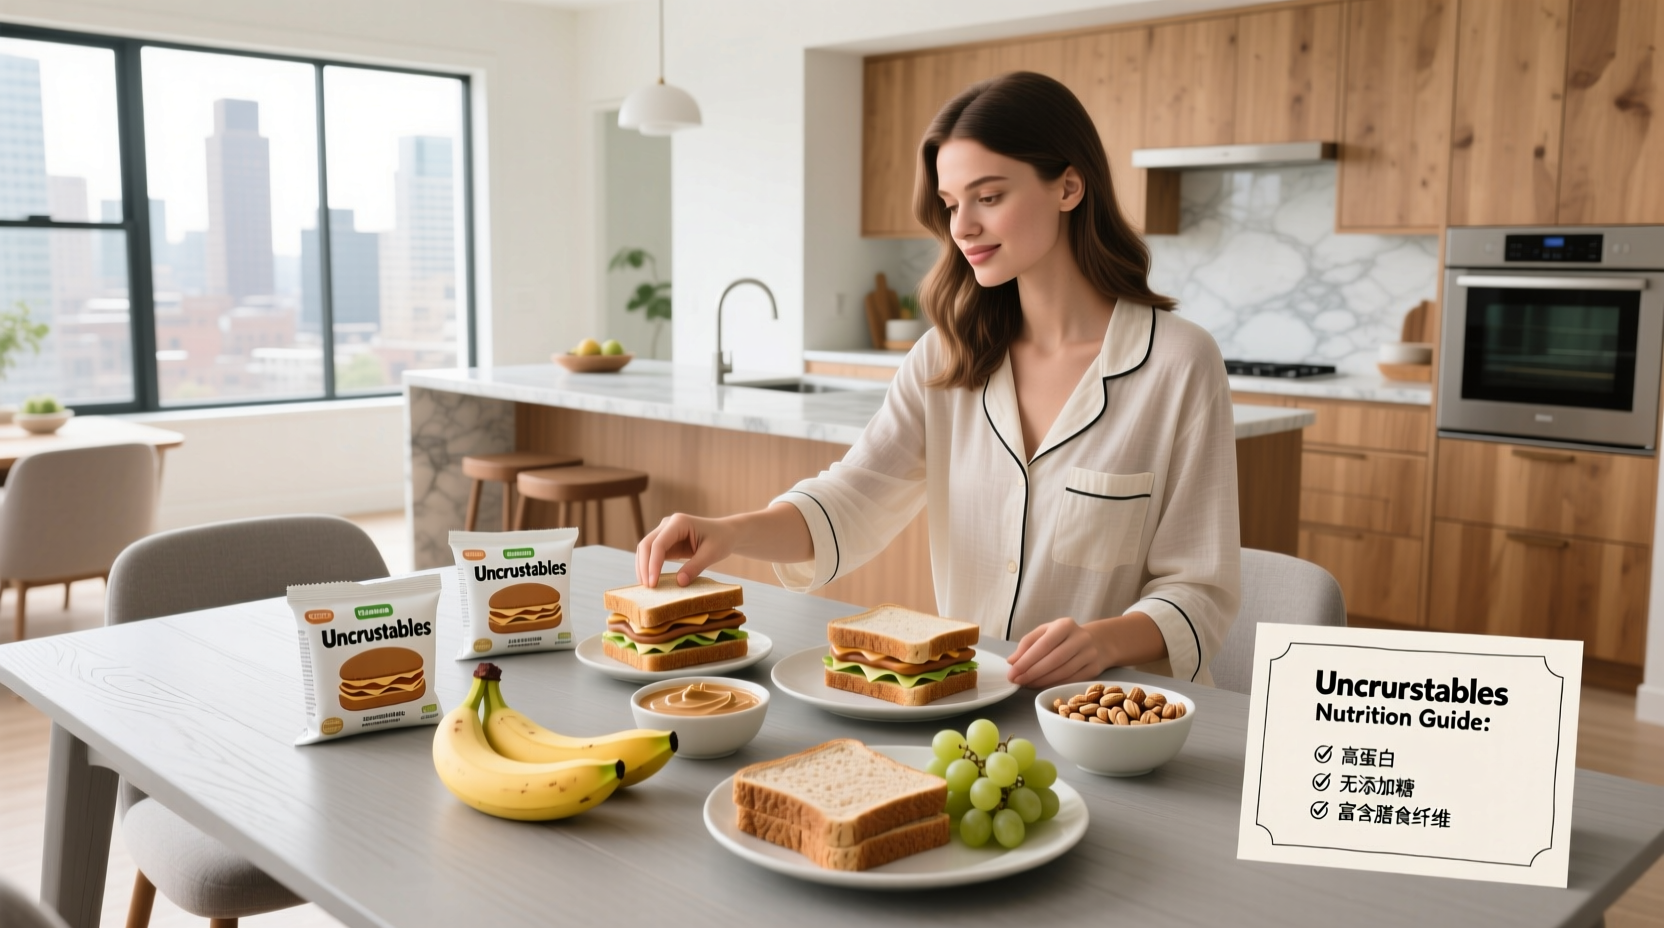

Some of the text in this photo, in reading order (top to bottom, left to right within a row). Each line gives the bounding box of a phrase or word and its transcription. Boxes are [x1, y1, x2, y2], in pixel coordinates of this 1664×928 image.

[474, 560, 567, 581] Uncrustables
[321, 618, 432, 648] Uncrustables
[1315, 669, 1509, 706] Uncrurstables
[1315, 703, 1491, 731] Nutrition Guide:
[1341, 746, 1395, 768] 高蛋白
[1339, 774, 1415, 798] 无添加糖
[1338, 801, 1451, 828] 富含膳食纤维
